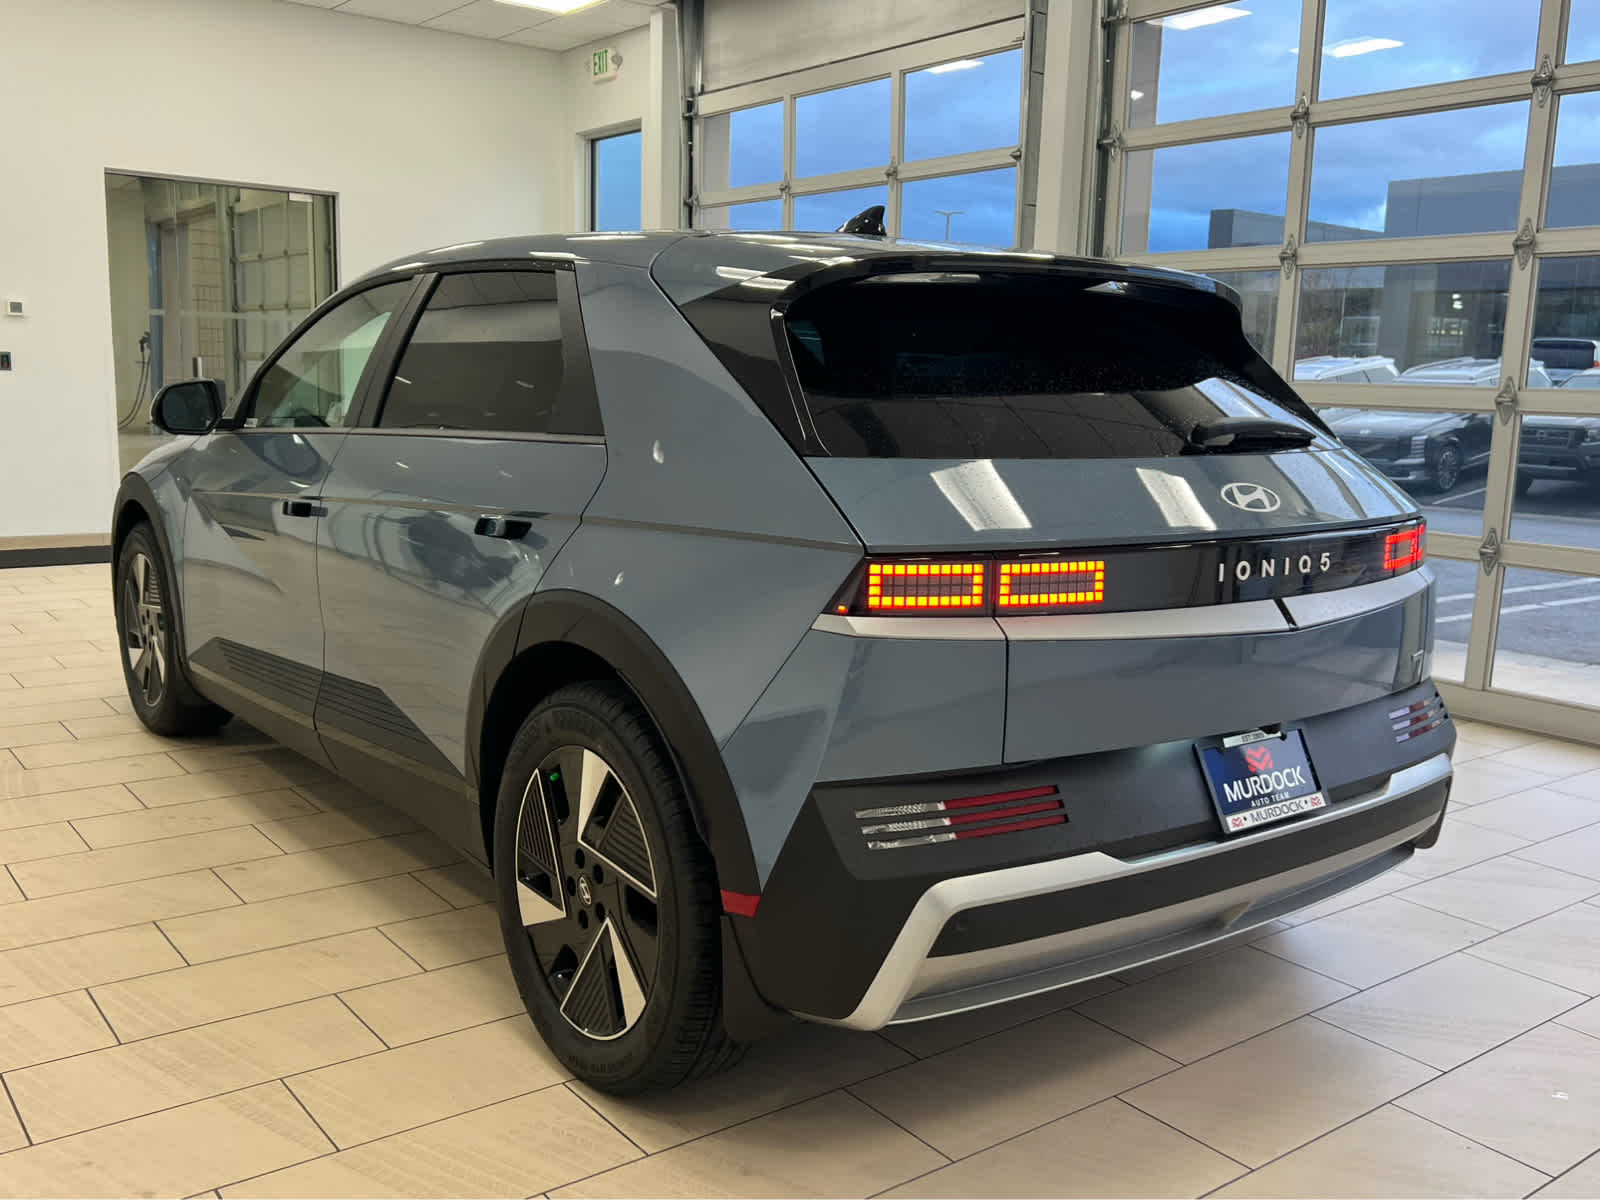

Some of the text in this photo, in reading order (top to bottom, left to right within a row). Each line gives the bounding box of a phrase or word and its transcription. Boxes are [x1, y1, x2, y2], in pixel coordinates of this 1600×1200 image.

[592, 49, 609, 76] EXIT
[1223, 766, 1306, 803] MURDOCK
[1250, 799, 1305, 823] MURDOCK
[1251, 791, 1290, 808] AUTO TEAM
